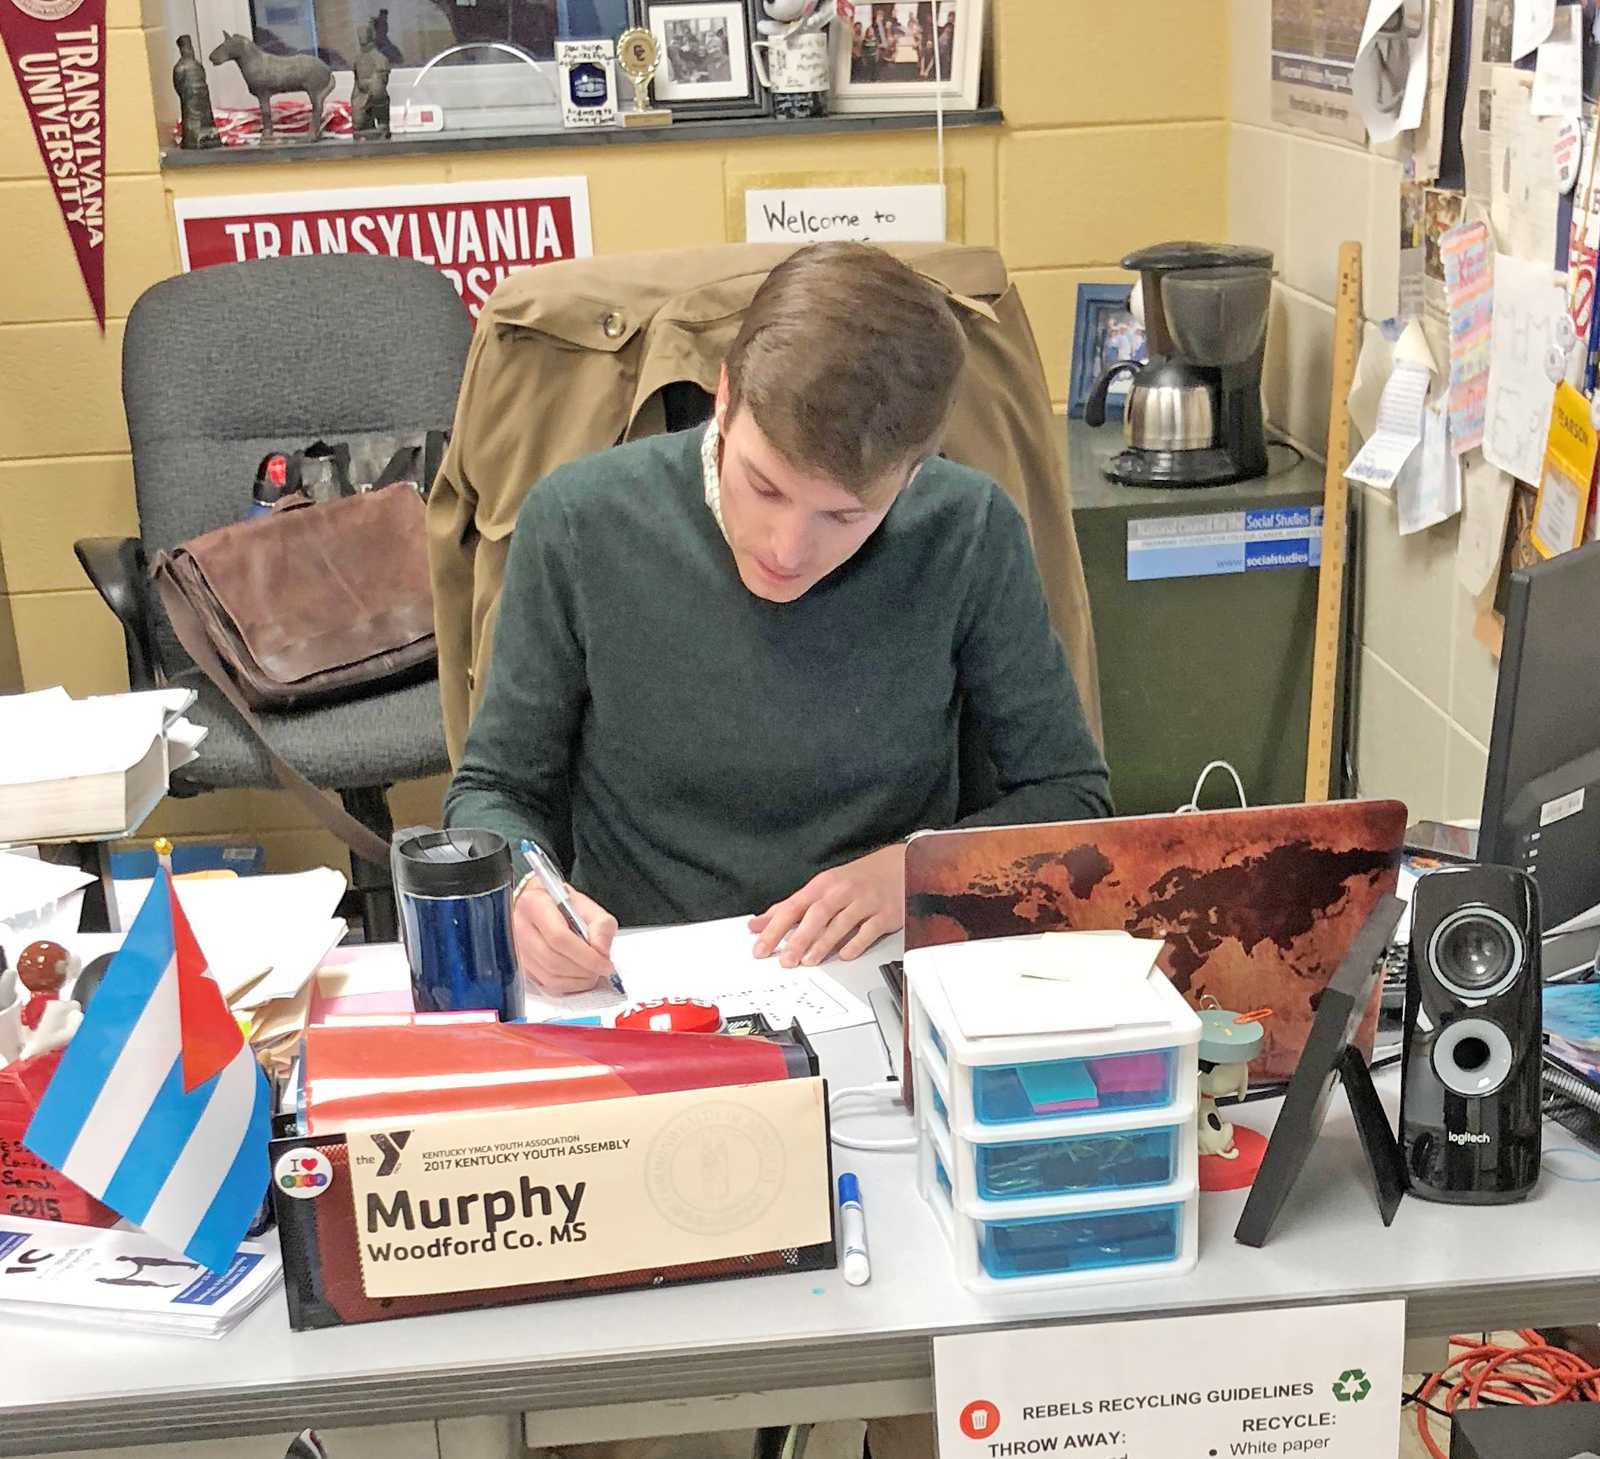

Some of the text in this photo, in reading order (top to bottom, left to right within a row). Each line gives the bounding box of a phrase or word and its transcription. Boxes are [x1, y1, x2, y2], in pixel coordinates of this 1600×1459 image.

[18, 52, 85, 224] UNIVERSITY
[55, 24, 104, 249] TRANSYLVANIA
[763, 200, 896, 234] Welcome to
[225, 205, 562, 265] TRANSYLVANIA
[1246, 514, 1274, 529] Social
[1275, 512, 1309, 527] Studies
[422, 1134, 580, 1160] KENTUCKY YMCA YOUTH ASSOCIATION
[1448, 1131, 1490, 1145] logitech
[356, 1155, 376, 1165] the
[424, 1138, 631, 1172] 2017 KENTUCKY YOUTH ASSEMBLY
[6, 1194, 63, 1221] 2015
[367, 1176, 586, 1233] Murphy
[367, 1222, 587, 1262] Woodford Co. MS
[1023, 1382, 1314, 1420] REBELS RECYCLING GUIDELINES
[1242, 1412, 1337, 1432] RECYCLE:
[988, 1430, 1127, 1458] THROW AWAY:
[1230, 1437, 1331, 1456] White paper
